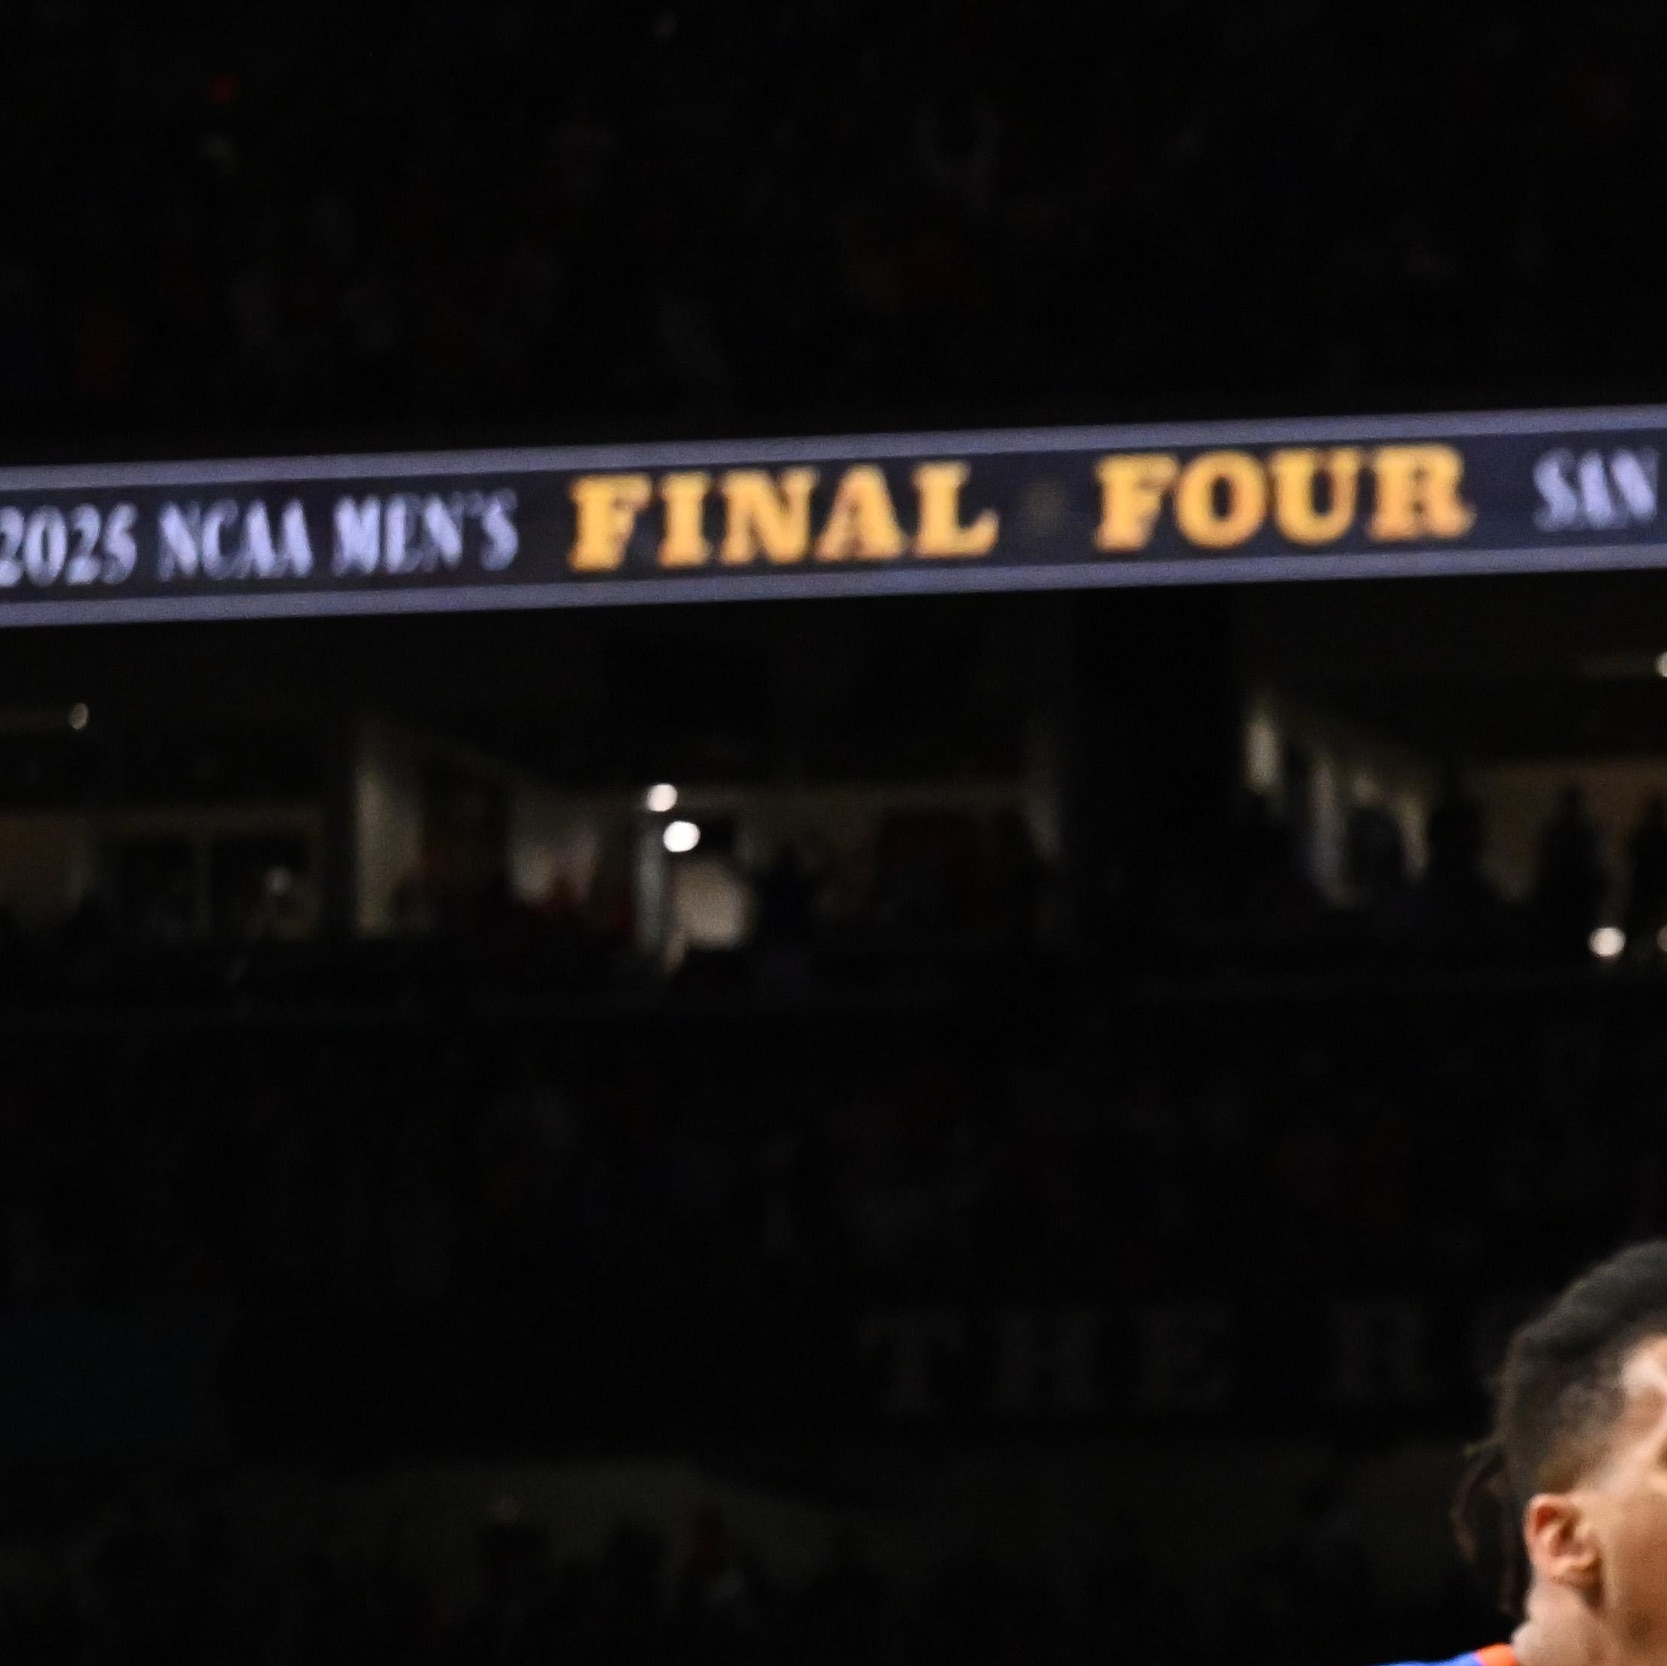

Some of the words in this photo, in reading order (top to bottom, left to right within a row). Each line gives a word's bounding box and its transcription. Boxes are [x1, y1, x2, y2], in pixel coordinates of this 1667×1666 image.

[0, 503, 138, 588] 2025
[156, 500, 315, 583] NCAA
[331, 488, 520, 574] MEN'S
[568, 461, 998, 572] FINAL
[1093, 444, 1476, 553] FOUR
[1534, 448, 1657, 534] SAN
